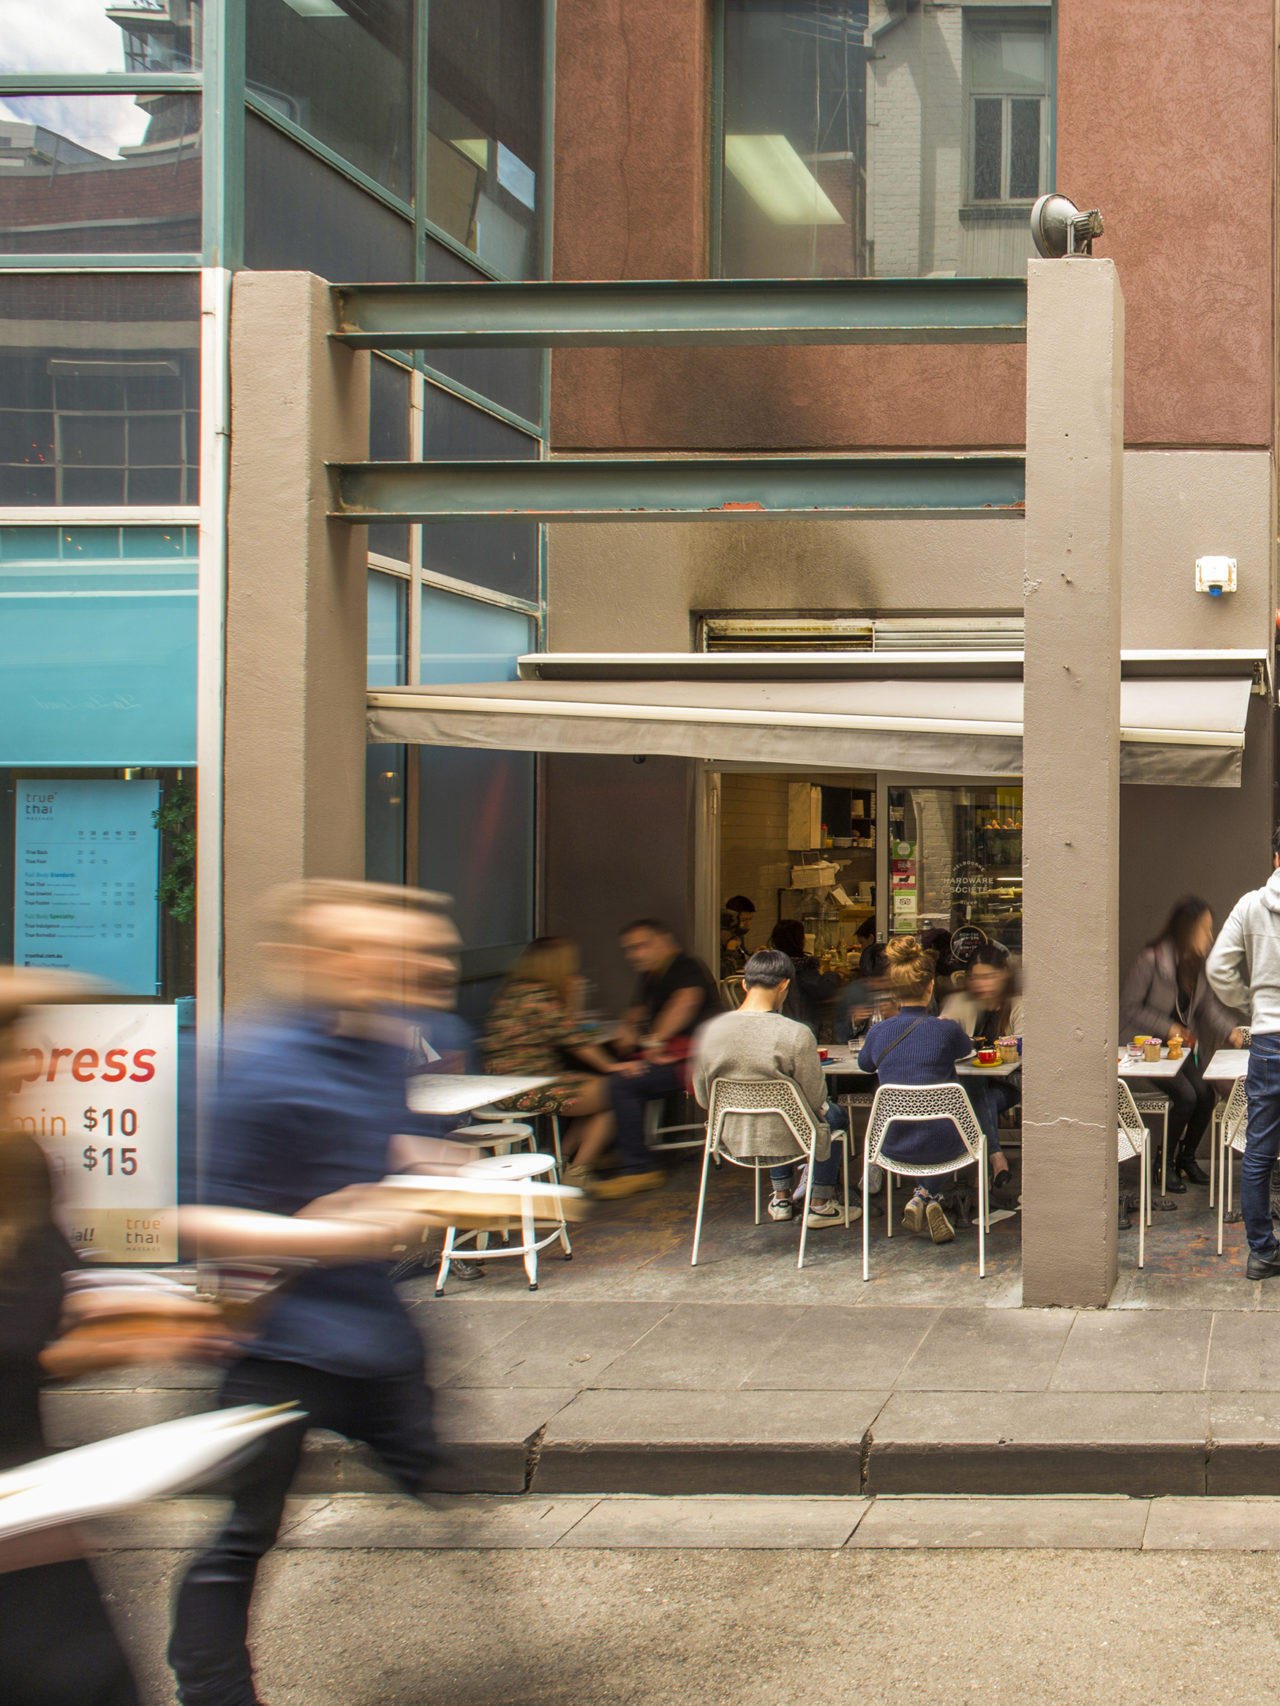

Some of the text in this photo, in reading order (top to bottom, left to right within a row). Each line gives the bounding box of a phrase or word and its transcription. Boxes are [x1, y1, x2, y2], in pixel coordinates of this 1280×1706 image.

[25, 793, 55, 803] true
[25, 804, 54, 814] thai
[952, 860, 985, 872] MELBOURNE
[950, 884, 989, 894] SOCIÉTÉ
[83, 1106, 138, 1137] $10
[82, 1145, 138, 1176] $15
[126, 1218, 161, 1230] true
[126, 1231, 160, 1244] thai
